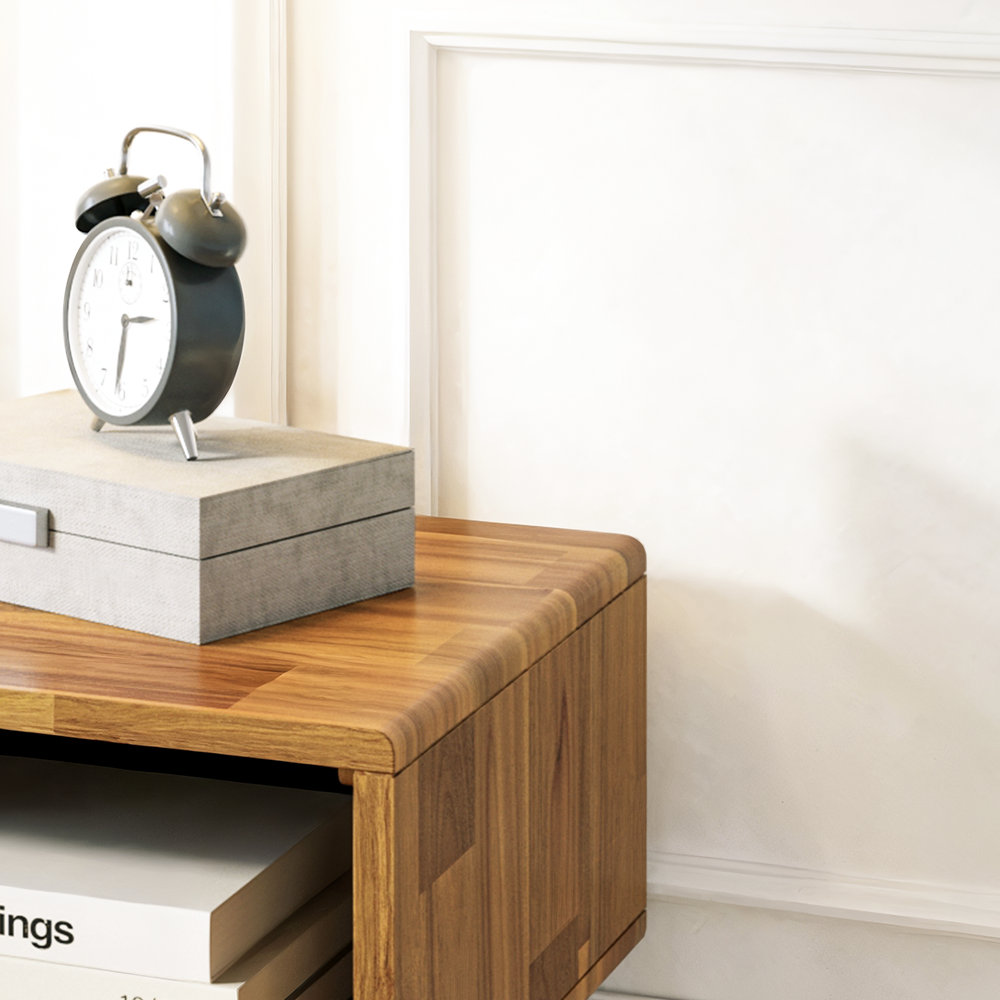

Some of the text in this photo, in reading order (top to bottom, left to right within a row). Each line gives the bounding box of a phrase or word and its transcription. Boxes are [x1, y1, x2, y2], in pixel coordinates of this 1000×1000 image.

[108, 245, 119, 267] 11
[127, 240, 139, 261] 12
[92, 268, 104, 288] 10
[100, 367, 108, 387] 7
